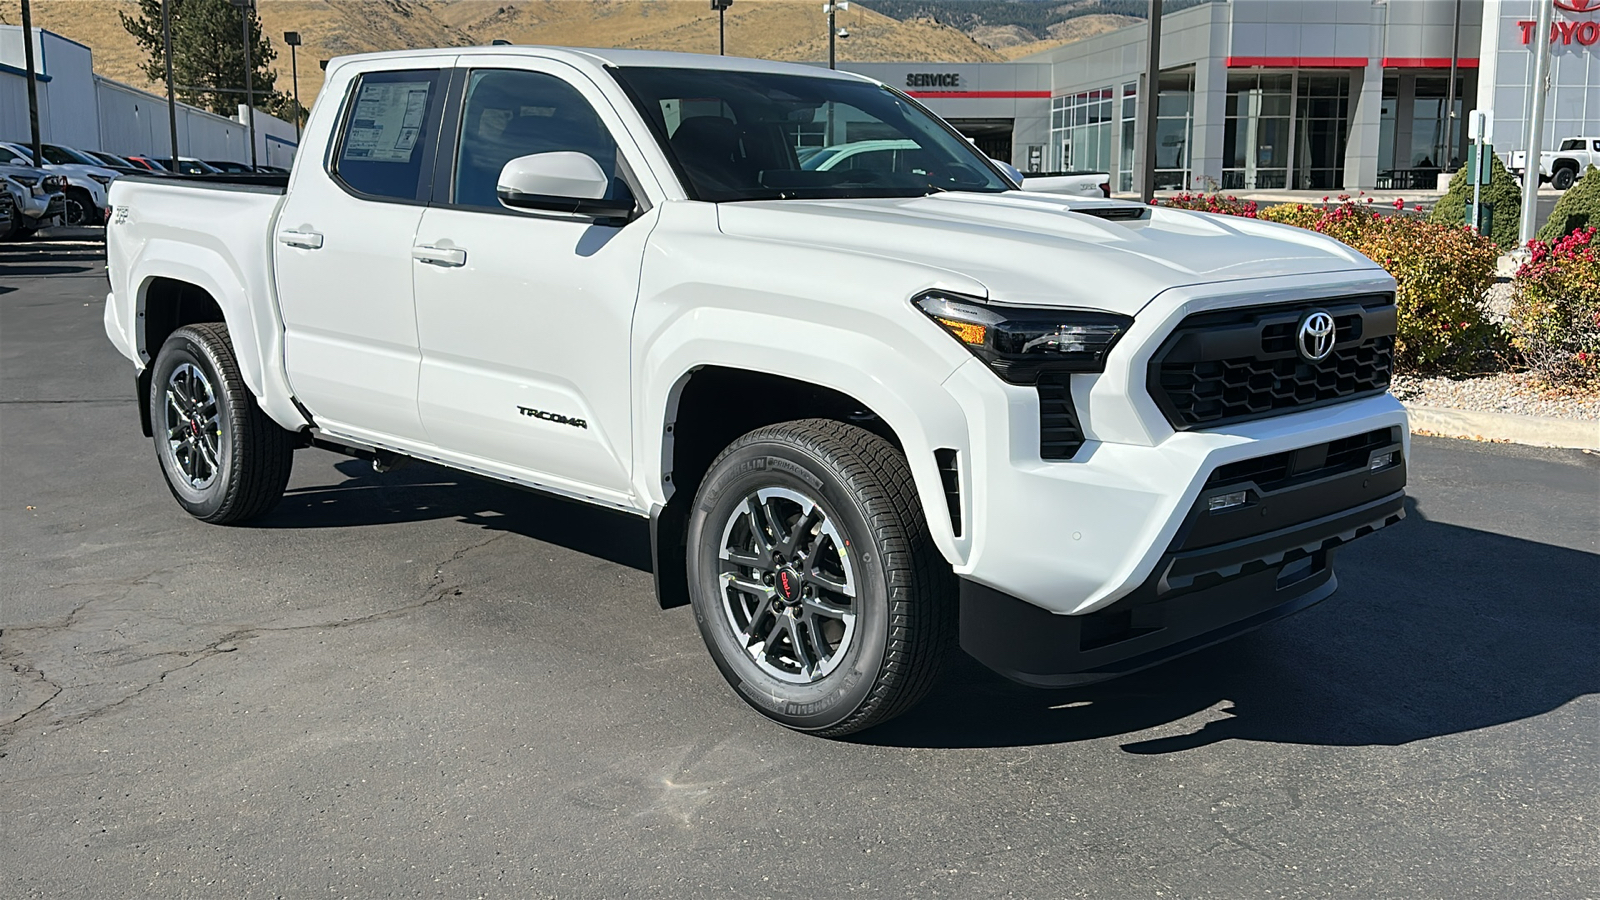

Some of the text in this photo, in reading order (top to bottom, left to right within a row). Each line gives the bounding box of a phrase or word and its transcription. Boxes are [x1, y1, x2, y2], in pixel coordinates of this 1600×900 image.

[1516, 20, 1600, 46] TYO
[906, 72, 960, 87] SERVICE
[516, 405, 588, 430] TACOMA
